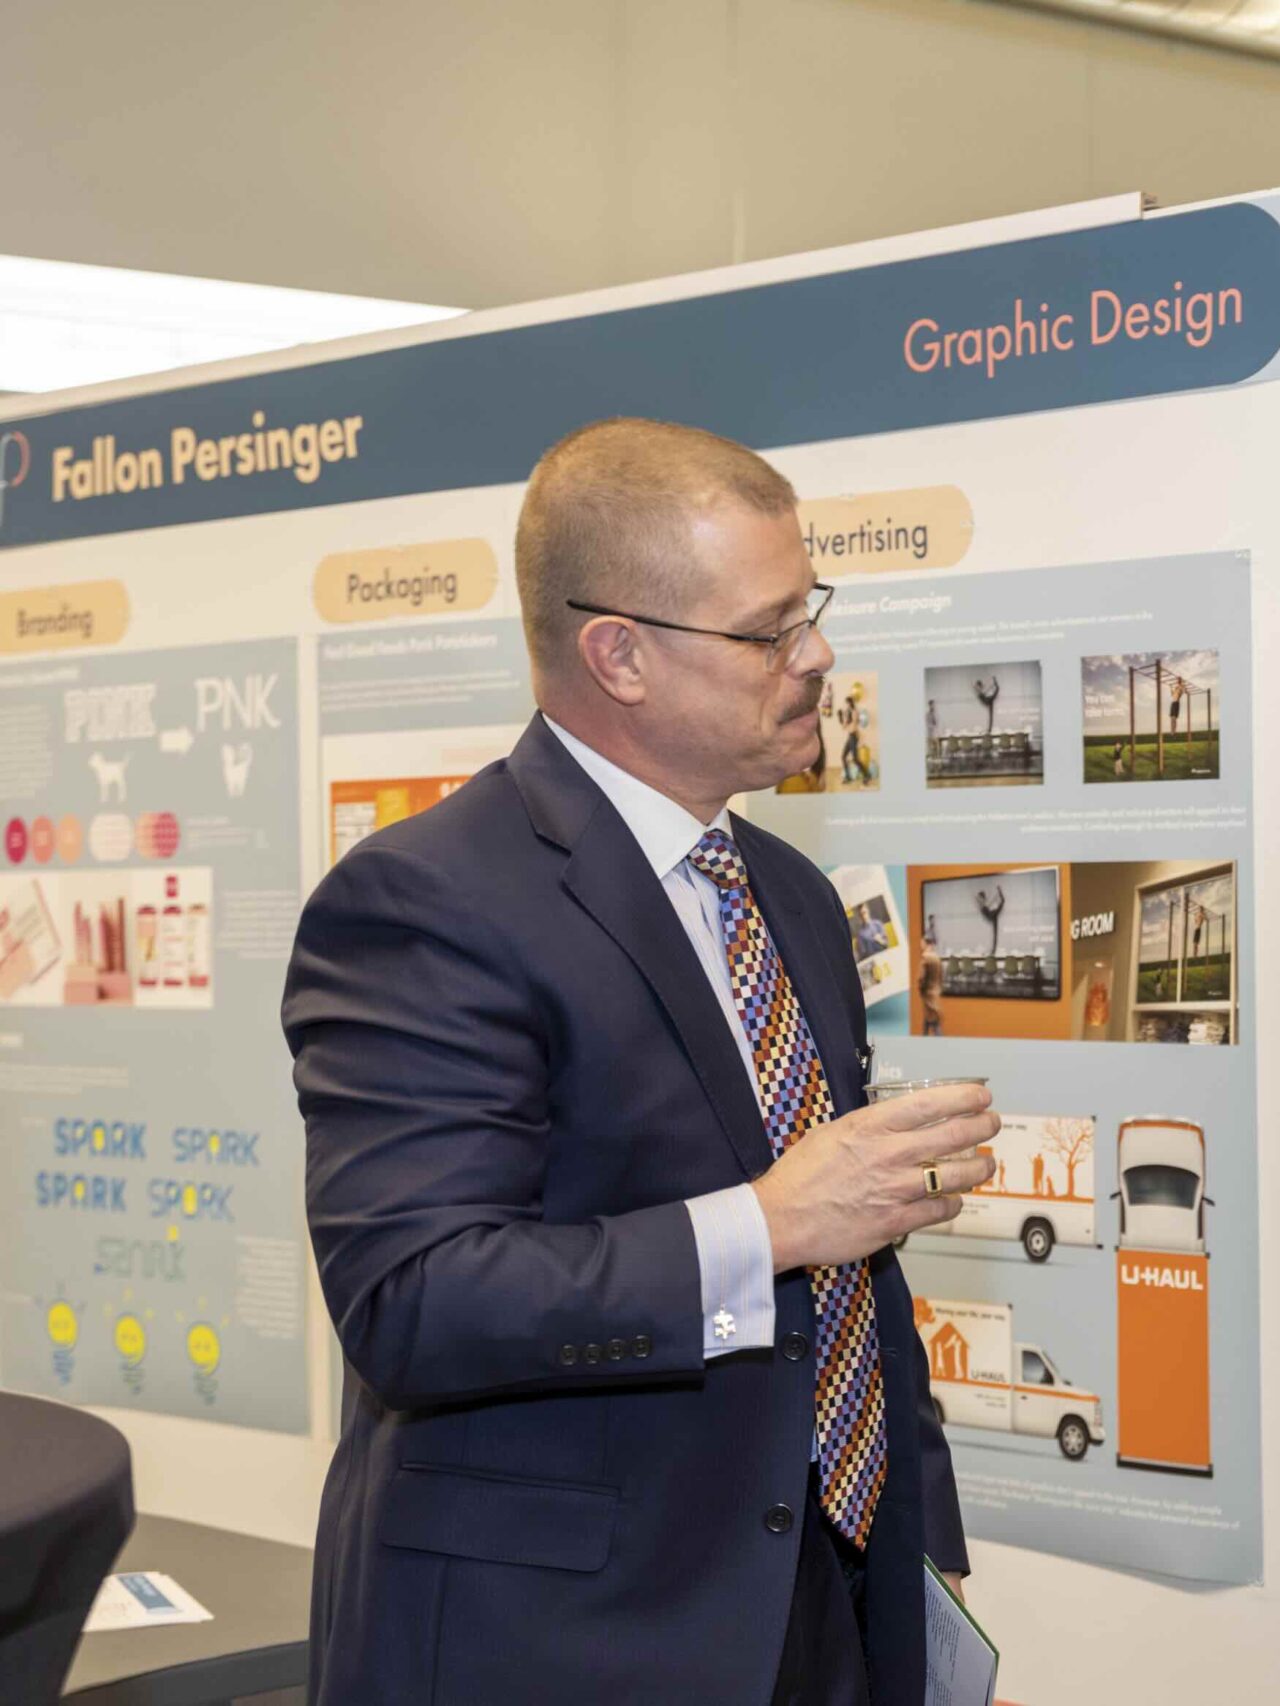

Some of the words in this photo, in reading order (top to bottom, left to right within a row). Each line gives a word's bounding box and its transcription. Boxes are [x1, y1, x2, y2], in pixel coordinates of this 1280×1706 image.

[904, 298, 1074, 379] Graphic
[1091, 281, 1242, 347] Design
[52, 434, 163, 502] Fallon
[171, 410, 363, 483] Persinger
[804, 517, 928, 559] dvertising
[347, 565, 457, 607] Packaging
[830, 599, 876, 616] leisure
[879, 591, 953, 615] Campaign
[16, 602, 94, 640] Branding
[194, 672, 282, 734] PNK
[1081, 909, 1114, 938] ROOM
[1120, 1263, 1204, 1291] U-HAUL
